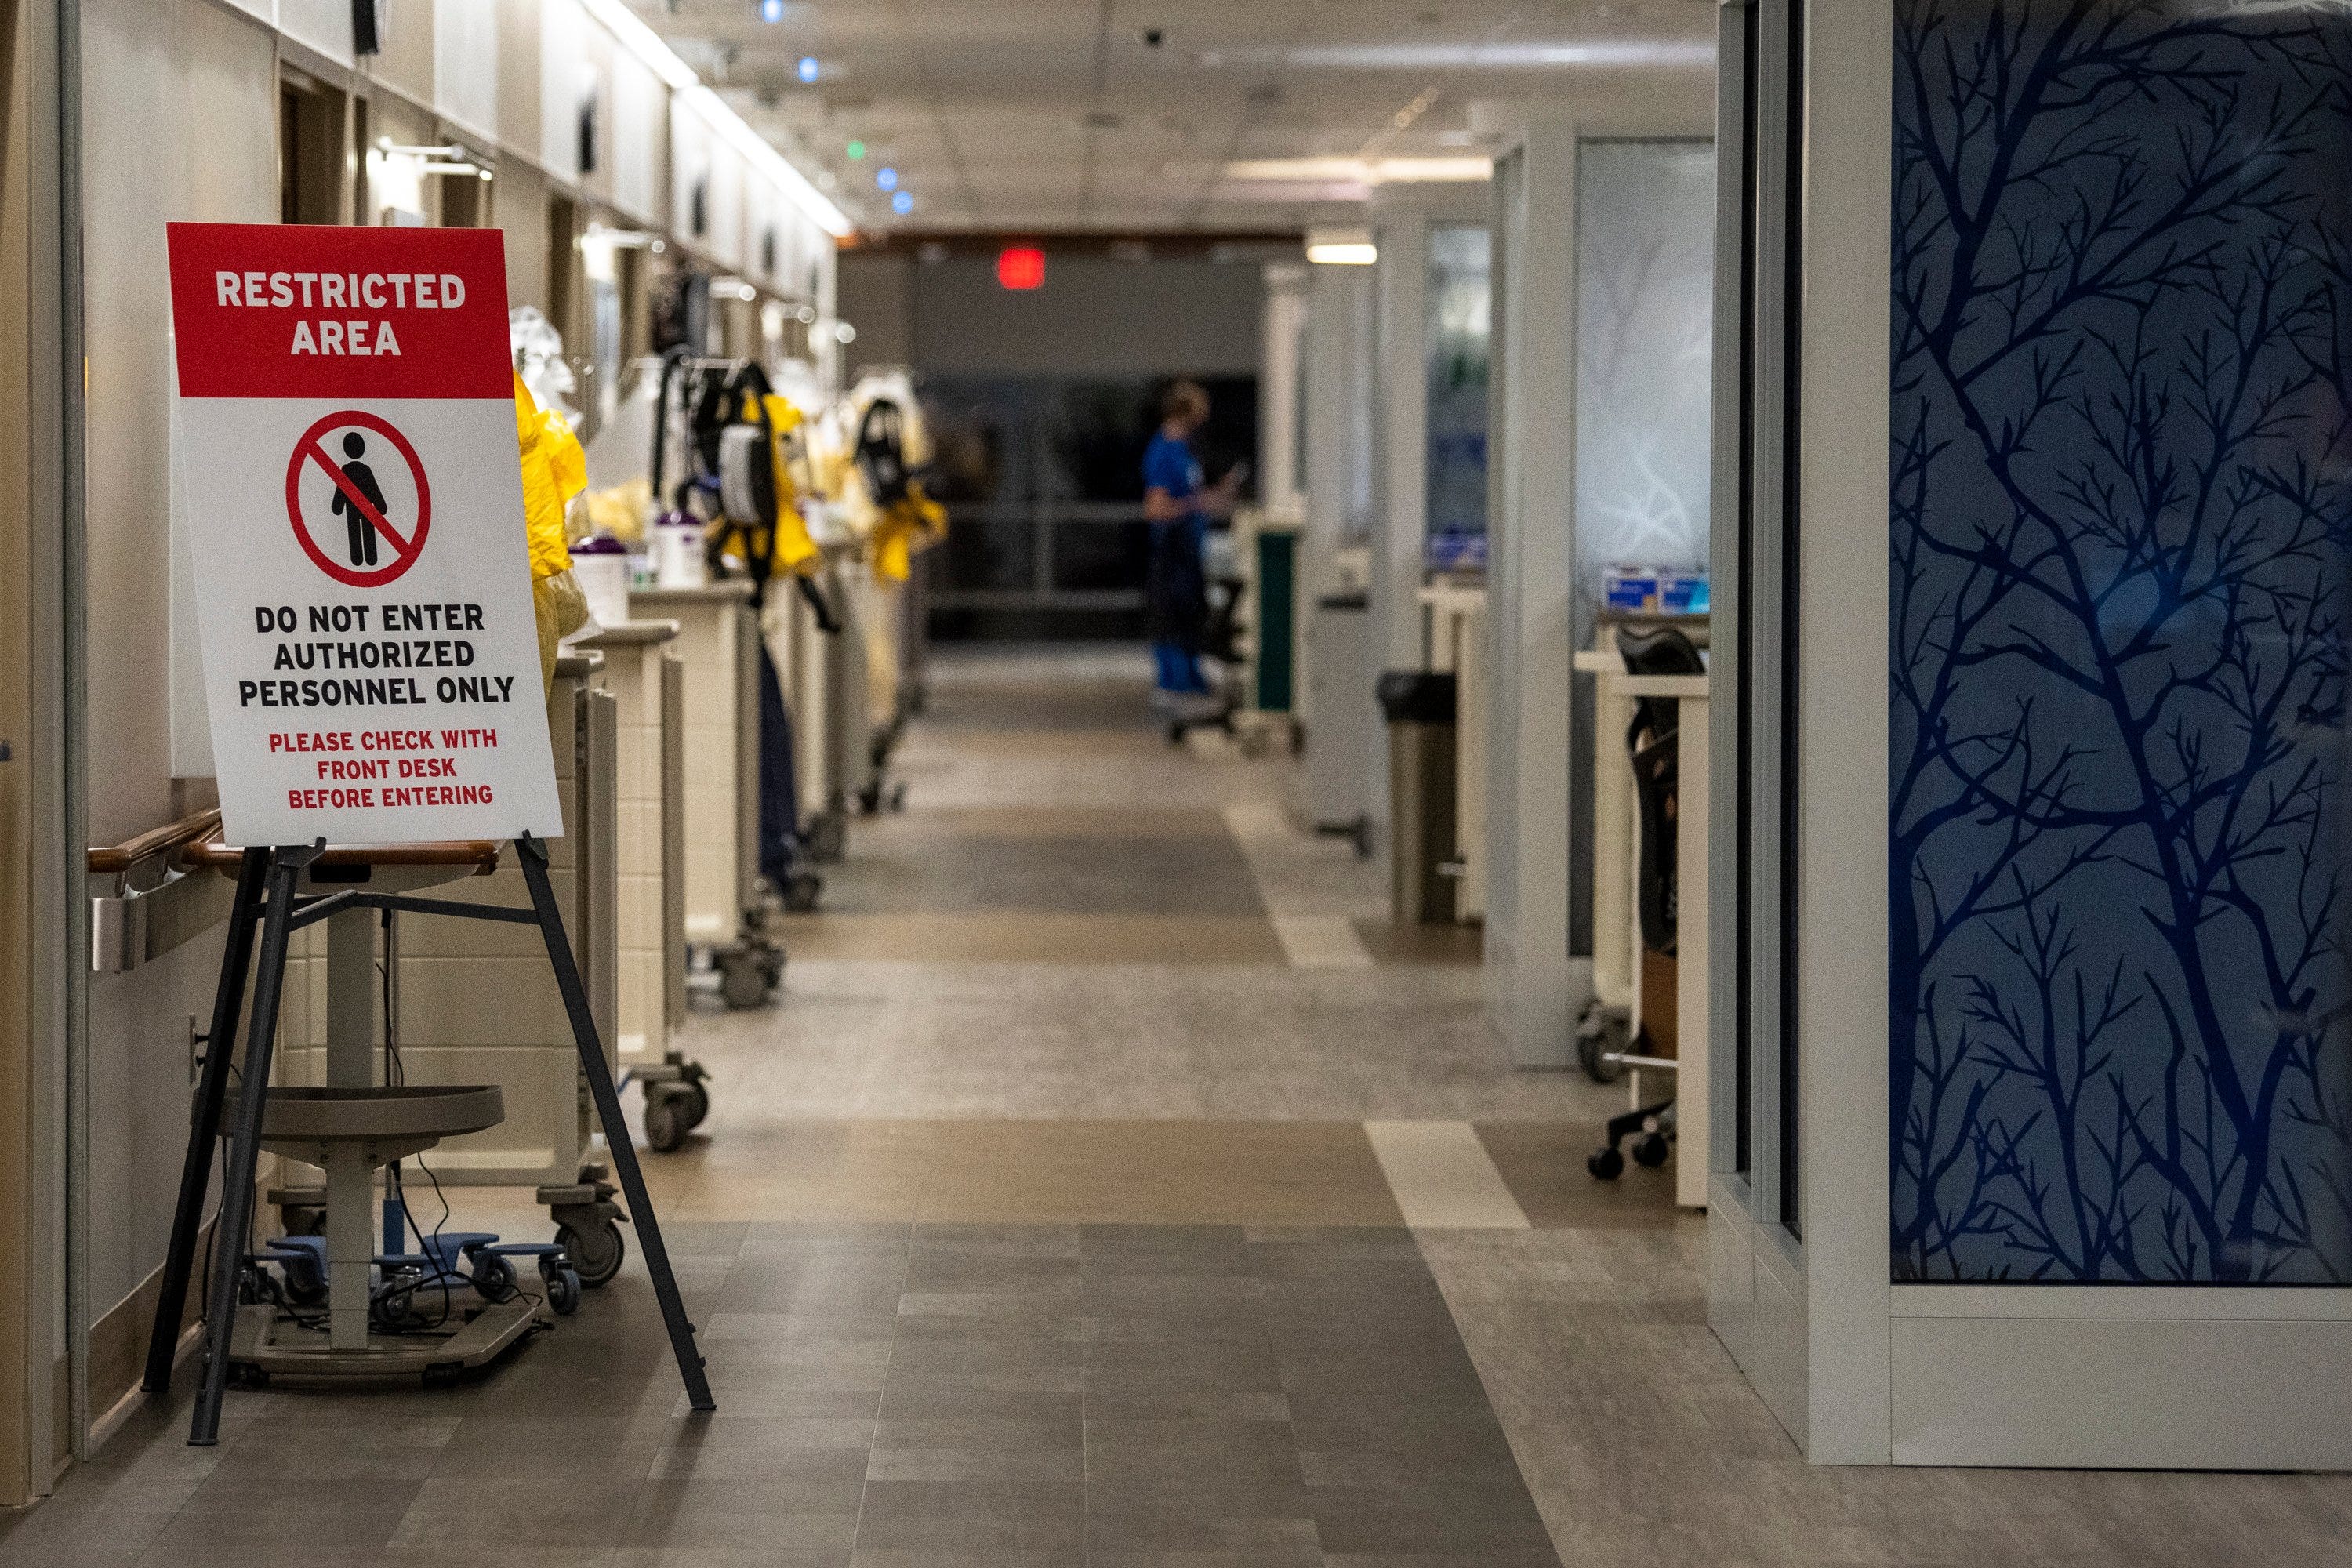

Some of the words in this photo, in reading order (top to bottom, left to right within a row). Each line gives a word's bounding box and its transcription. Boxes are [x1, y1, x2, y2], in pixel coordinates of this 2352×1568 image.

[216, 271, 465, 308] RESTRICTED
[291, 321, 401, 355] AREA
[256, 606, 296, 633] DO
[309, 606, 369, 632] NOT
[383, 604, 484, 631] ENTER
[274, 641, 474, 669] AUTHORIZED
[239, 678, 426, 706] PERSONNEL
[437, 677, 514, 703] ONLY
[270, 732, 354, 752] PLEASE
[361, 731, 433, 750] CHECK
[441, 729, 497, 748] WITH
[318, 760, 389, 779] FRONT
[398, 759, 456, 778] DESK
[289, 789, 374, 808] BEFORE
[382, 785, 492, 806] ENTERING
